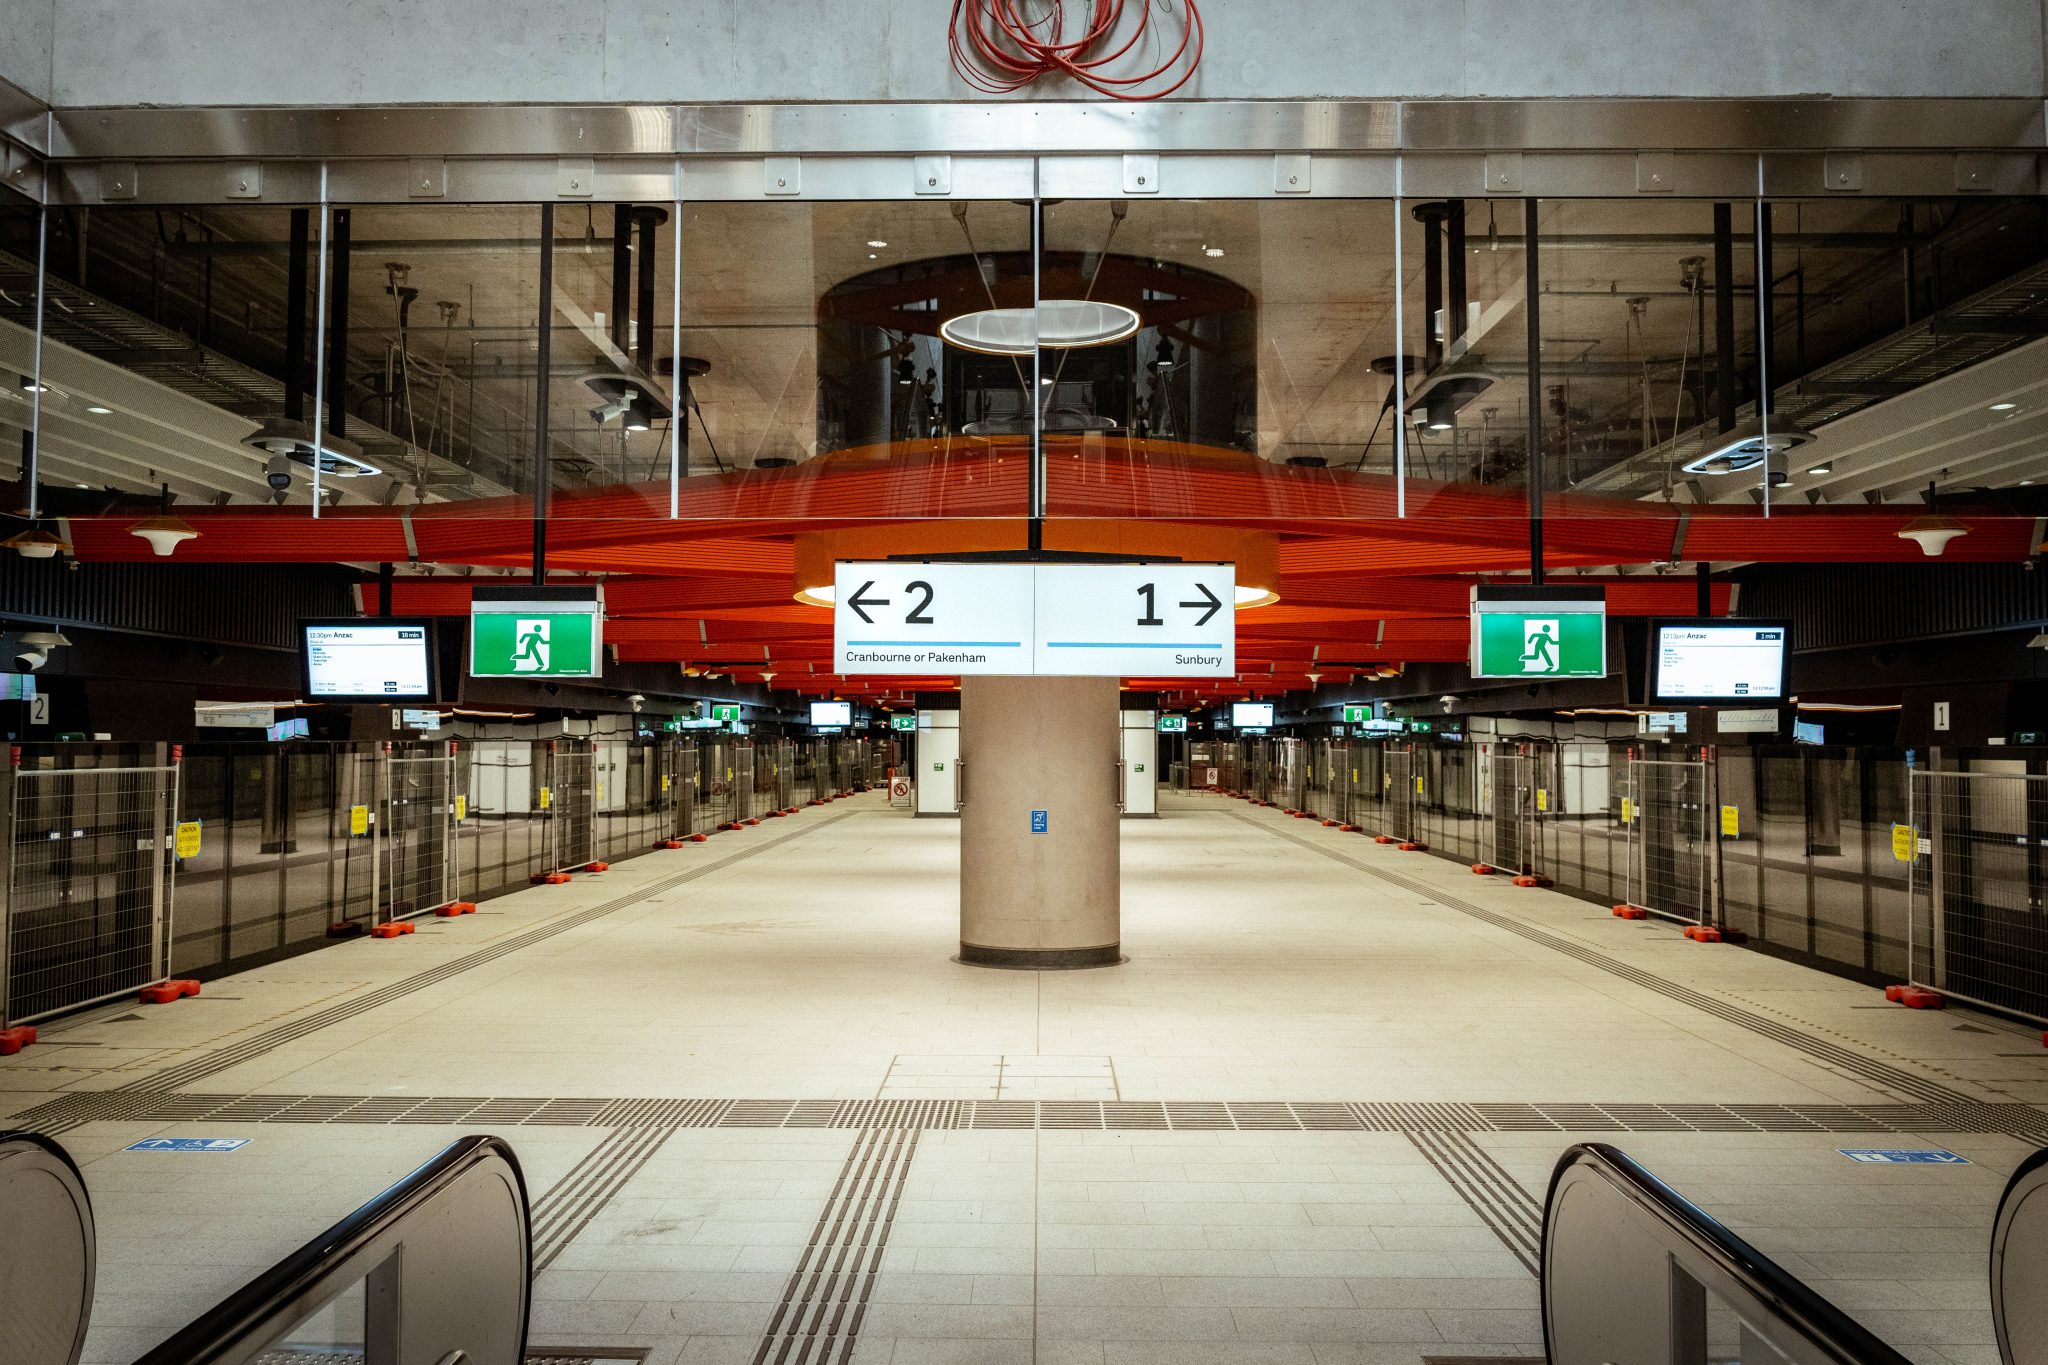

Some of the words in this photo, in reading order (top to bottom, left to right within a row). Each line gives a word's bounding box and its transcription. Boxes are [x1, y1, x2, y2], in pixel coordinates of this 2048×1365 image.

[905, 580, 934, 624] 2
[1137, 583, 1163, 626] 1
[846, 651, 911, 662] Cranbourne
[914, 654, 926, 662] or
[928, 652, 986, 663] Pakenham
[1175, 654, 1222, 667] Sunbury
[35, 697, 44, 720] 2
[1939, 706, 1945, 726] 1
